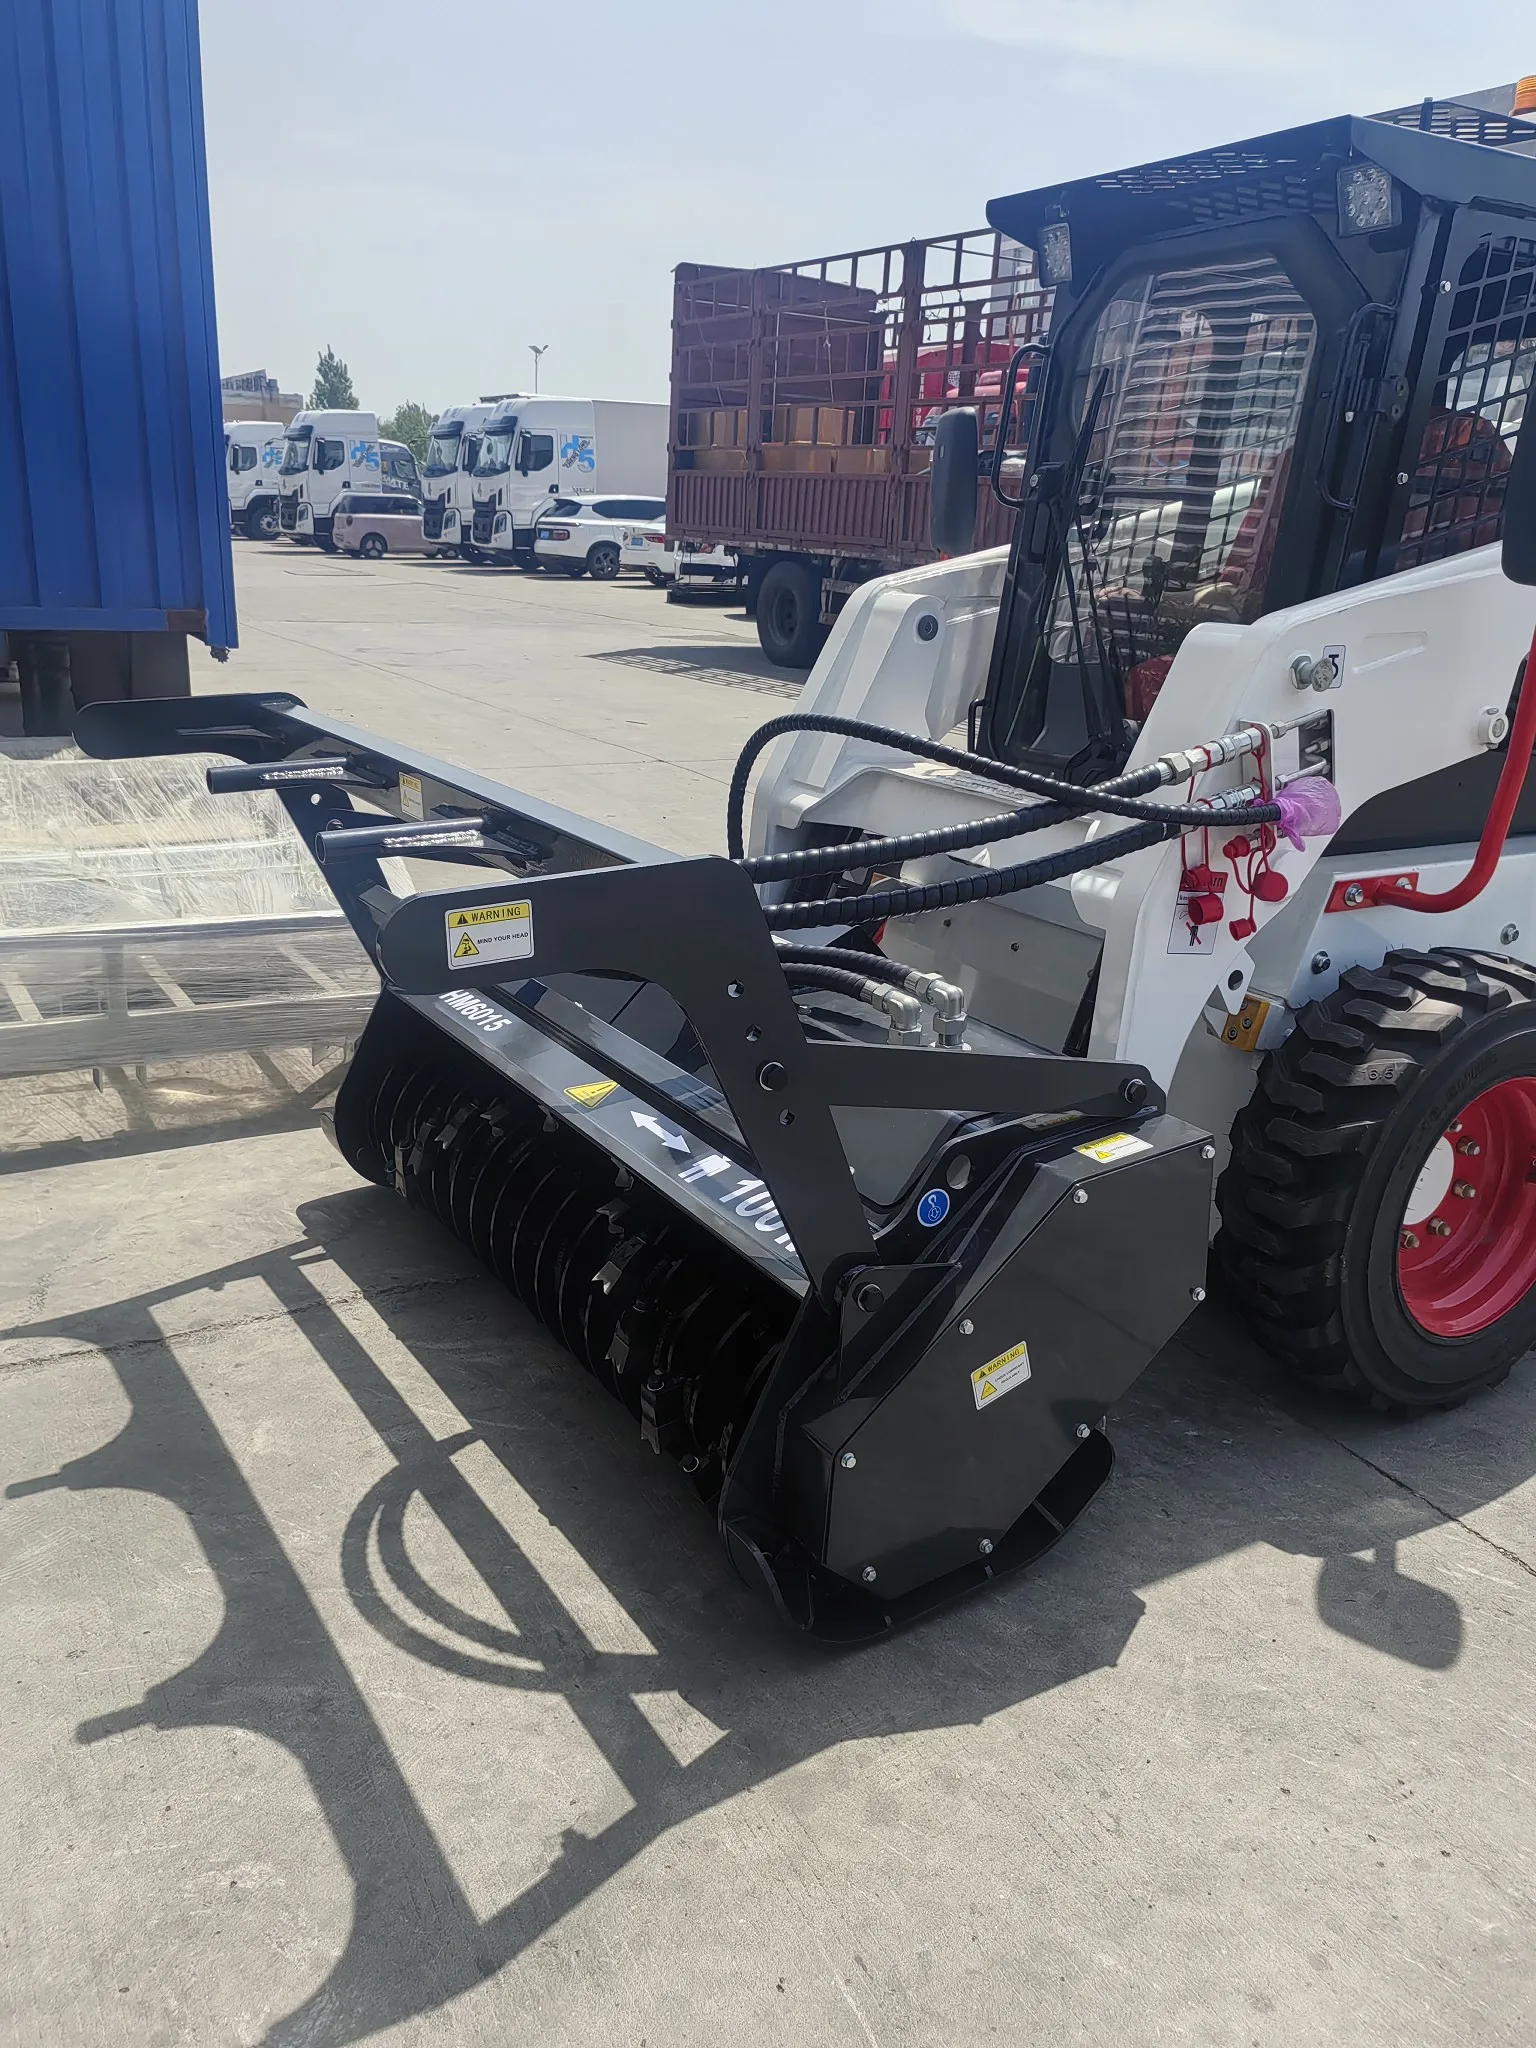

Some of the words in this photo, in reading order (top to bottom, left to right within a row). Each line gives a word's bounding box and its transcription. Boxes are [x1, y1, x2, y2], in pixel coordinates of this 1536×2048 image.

[471, 906, 521, 922] WARNING
[477, 936, 493, 944] MIND
[493, 934, 511, 942] YOUR
[438, 989, 513, 1032] HM6015
[719, 1179, 799, 1258] 100
[987, 1348, 1020, 1373] WARNING
